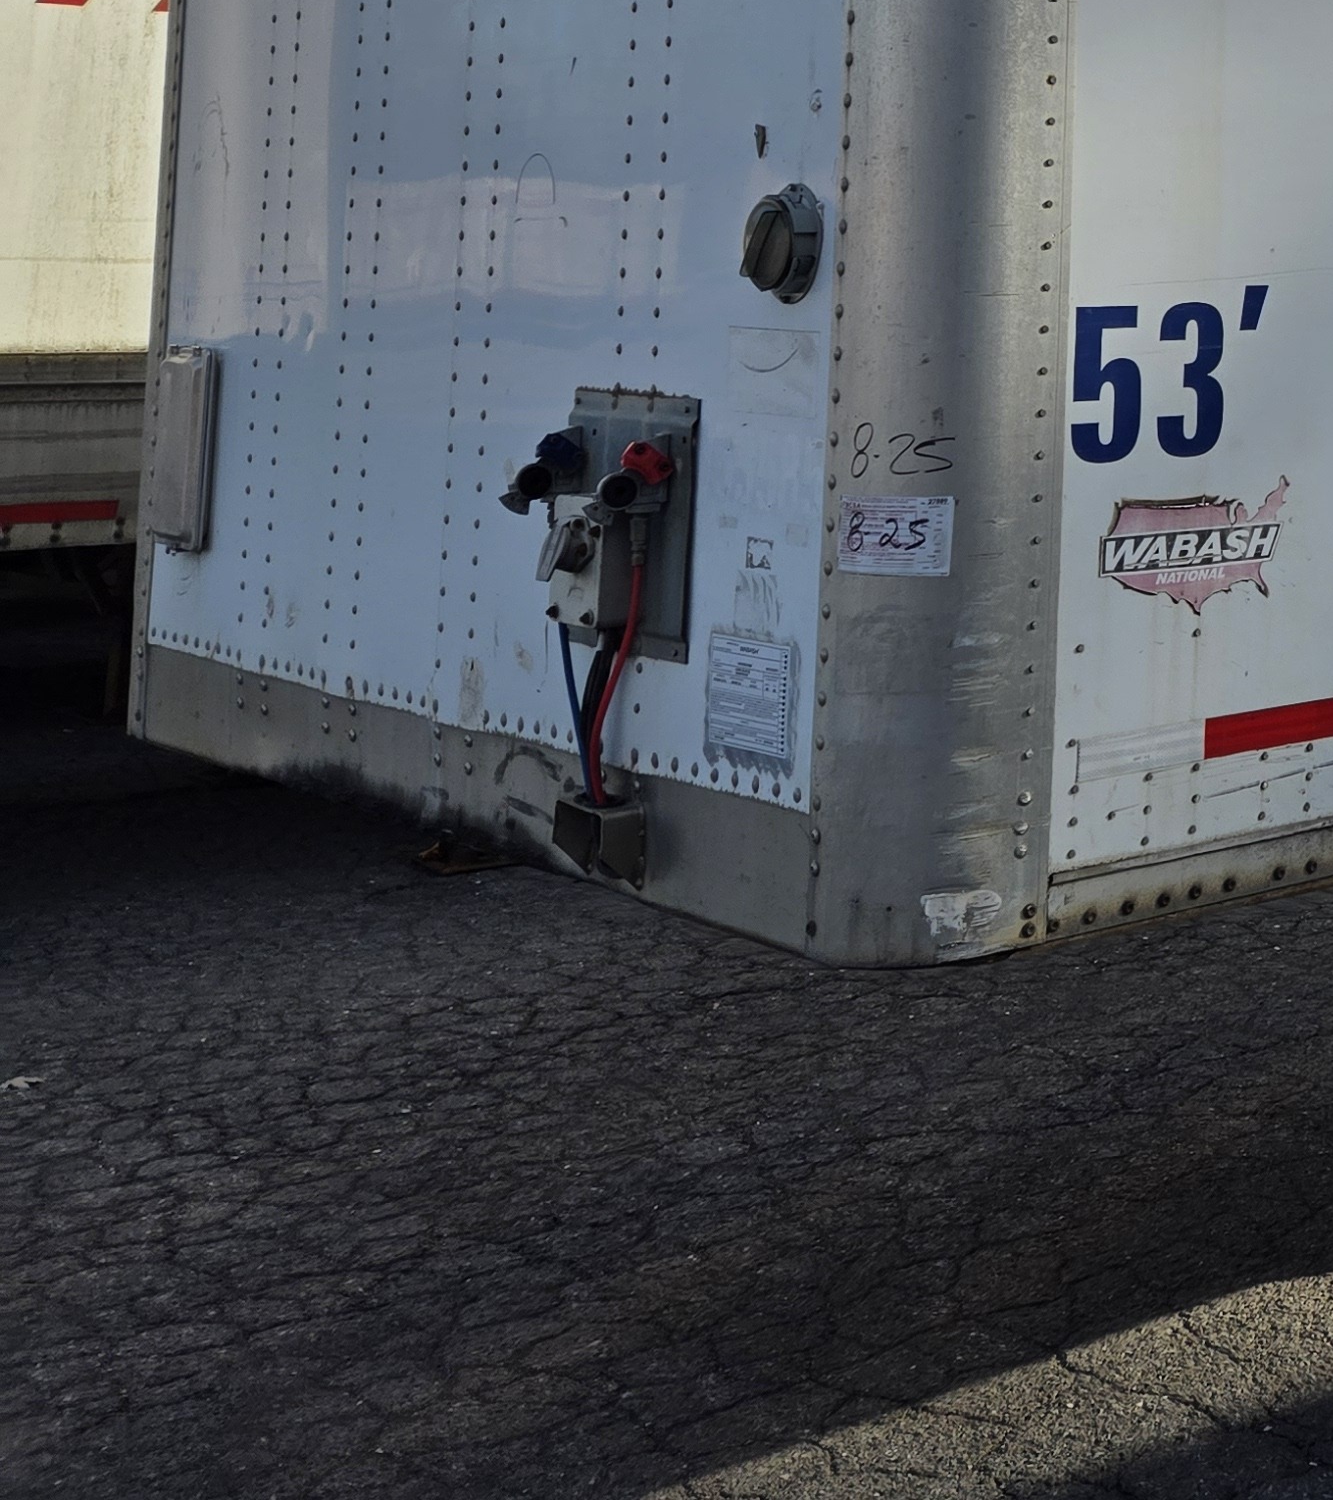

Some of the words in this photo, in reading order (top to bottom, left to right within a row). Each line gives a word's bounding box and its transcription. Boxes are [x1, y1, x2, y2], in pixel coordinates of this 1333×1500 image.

[1070, 284, 1269, 464] 53'
[851, 422, 956, 478] 8-25
[847, 511, 929, 552] 8-25
[1104, 526, 1279, 572] WABASH
[1155, 566, 1226, 586] NATIONAL
